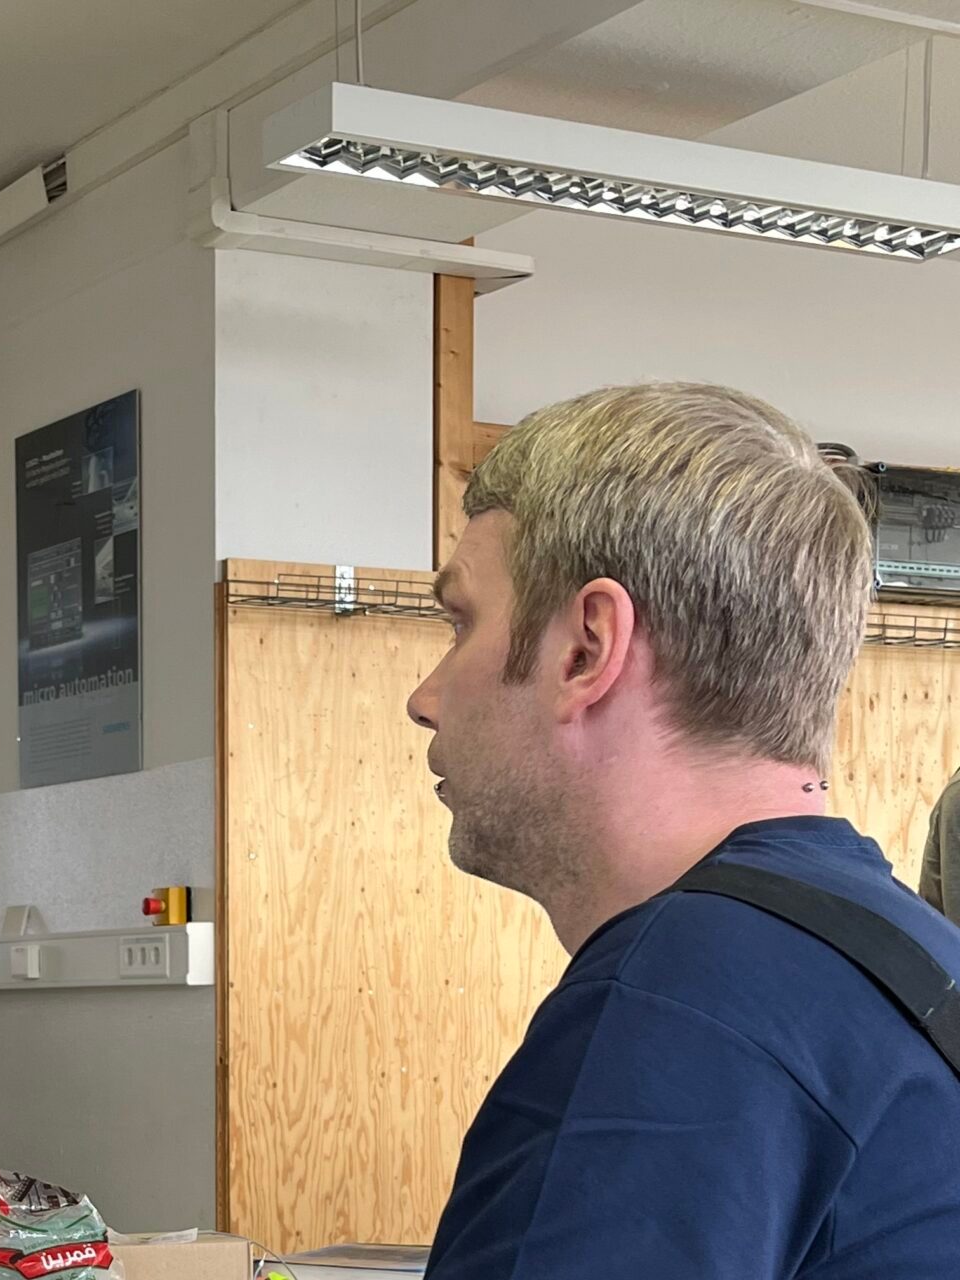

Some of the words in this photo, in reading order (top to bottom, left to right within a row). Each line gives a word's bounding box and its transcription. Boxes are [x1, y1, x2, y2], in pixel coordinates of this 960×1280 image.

[23, 683, 57, 706] micro
[59, 665, 134, 699] automation
[40, 1243, 97, 1270] قمرين
